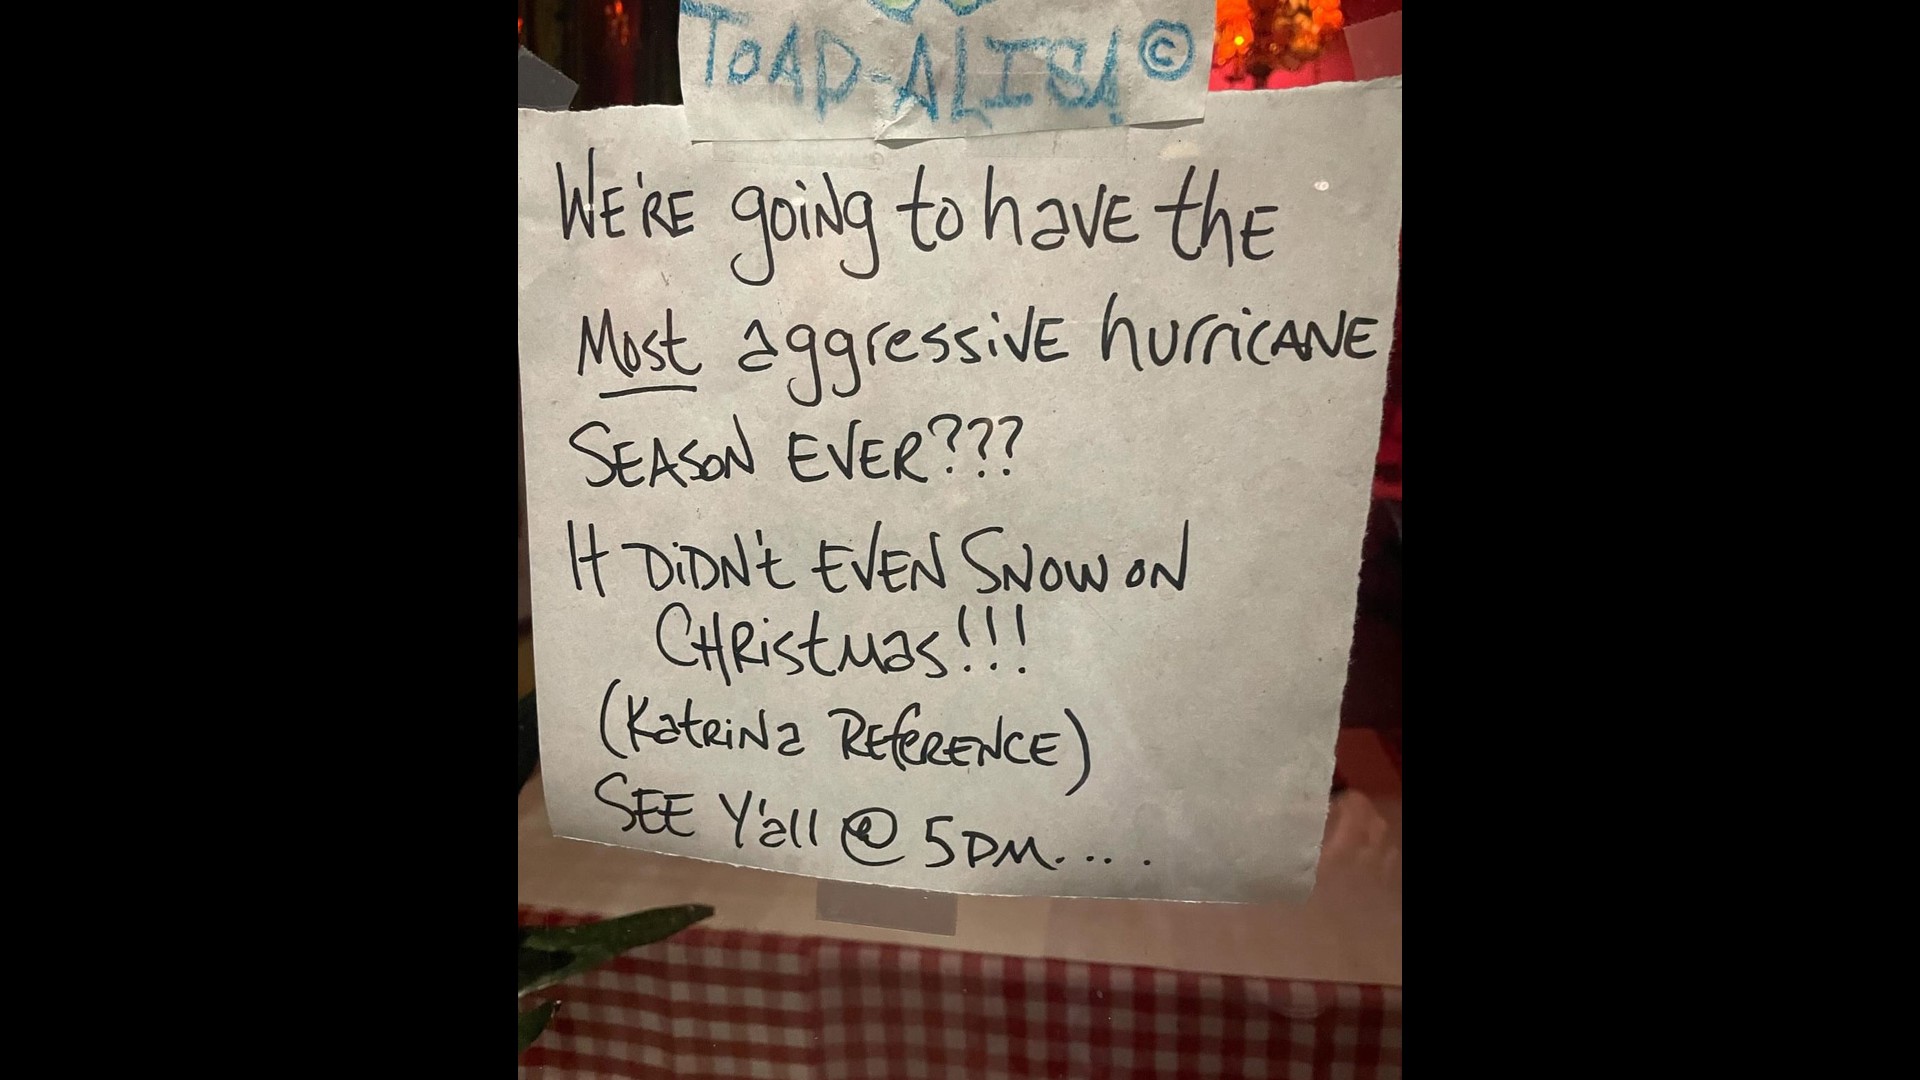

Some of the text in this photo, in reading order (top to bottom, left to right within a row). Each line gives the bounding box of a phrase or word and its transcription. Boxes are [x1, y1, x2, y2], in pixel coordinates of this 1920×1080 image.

[555, 146, 695, 241] WE'RE
[895, 164, 965, 253] to
[786, 412, 1025, 485] EVER???
[809, 519, 947, 595] EVEN
[959, 525, 1110, 595] SNOW
[593, 770, 696, 840] SEE
[717, 789, 819, 850] Y'all
[839, 805, 907, 868] @
